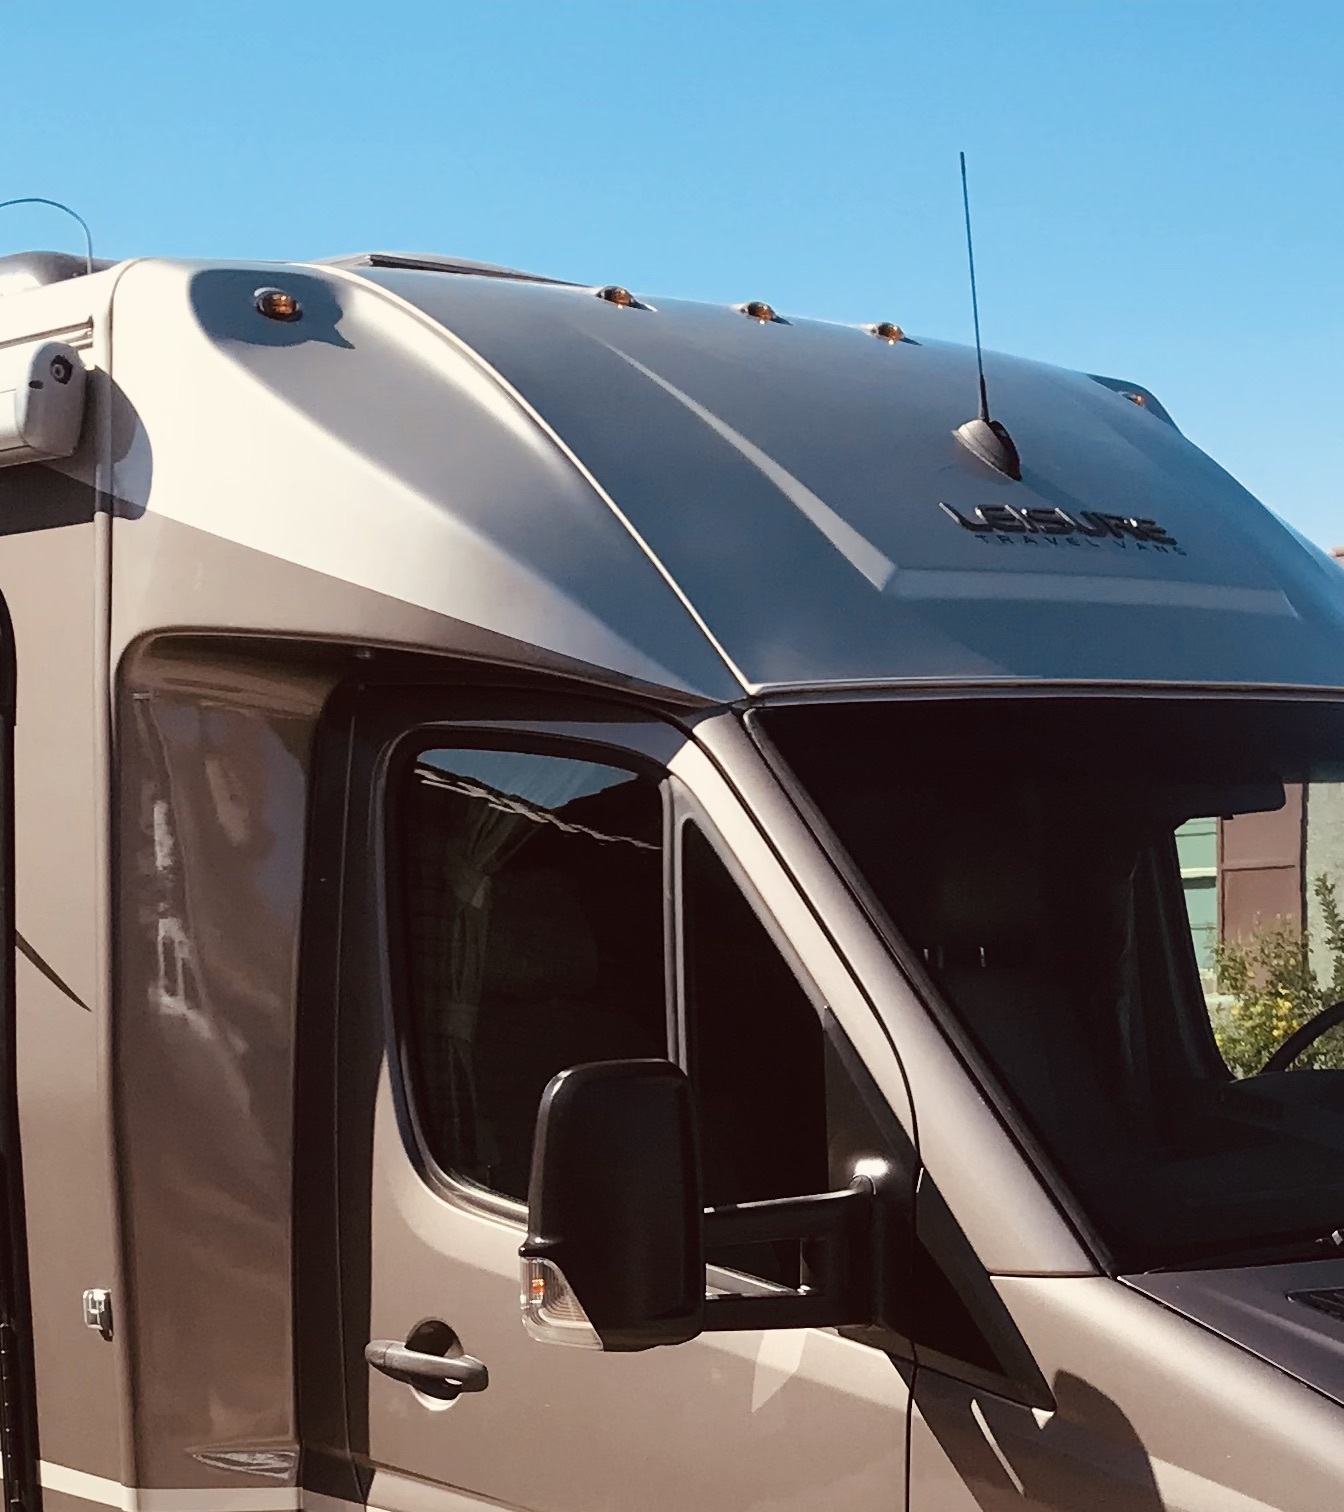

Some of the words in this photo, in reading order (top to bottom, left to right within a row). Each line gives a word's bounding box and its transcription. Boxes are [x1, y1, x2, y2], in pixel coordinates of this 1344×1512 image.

[938, 502, 1178, 545] LEISURE
[974, 534, 1101, 548] TRAVEL
[1112, 540, 1187, 556] VANS
